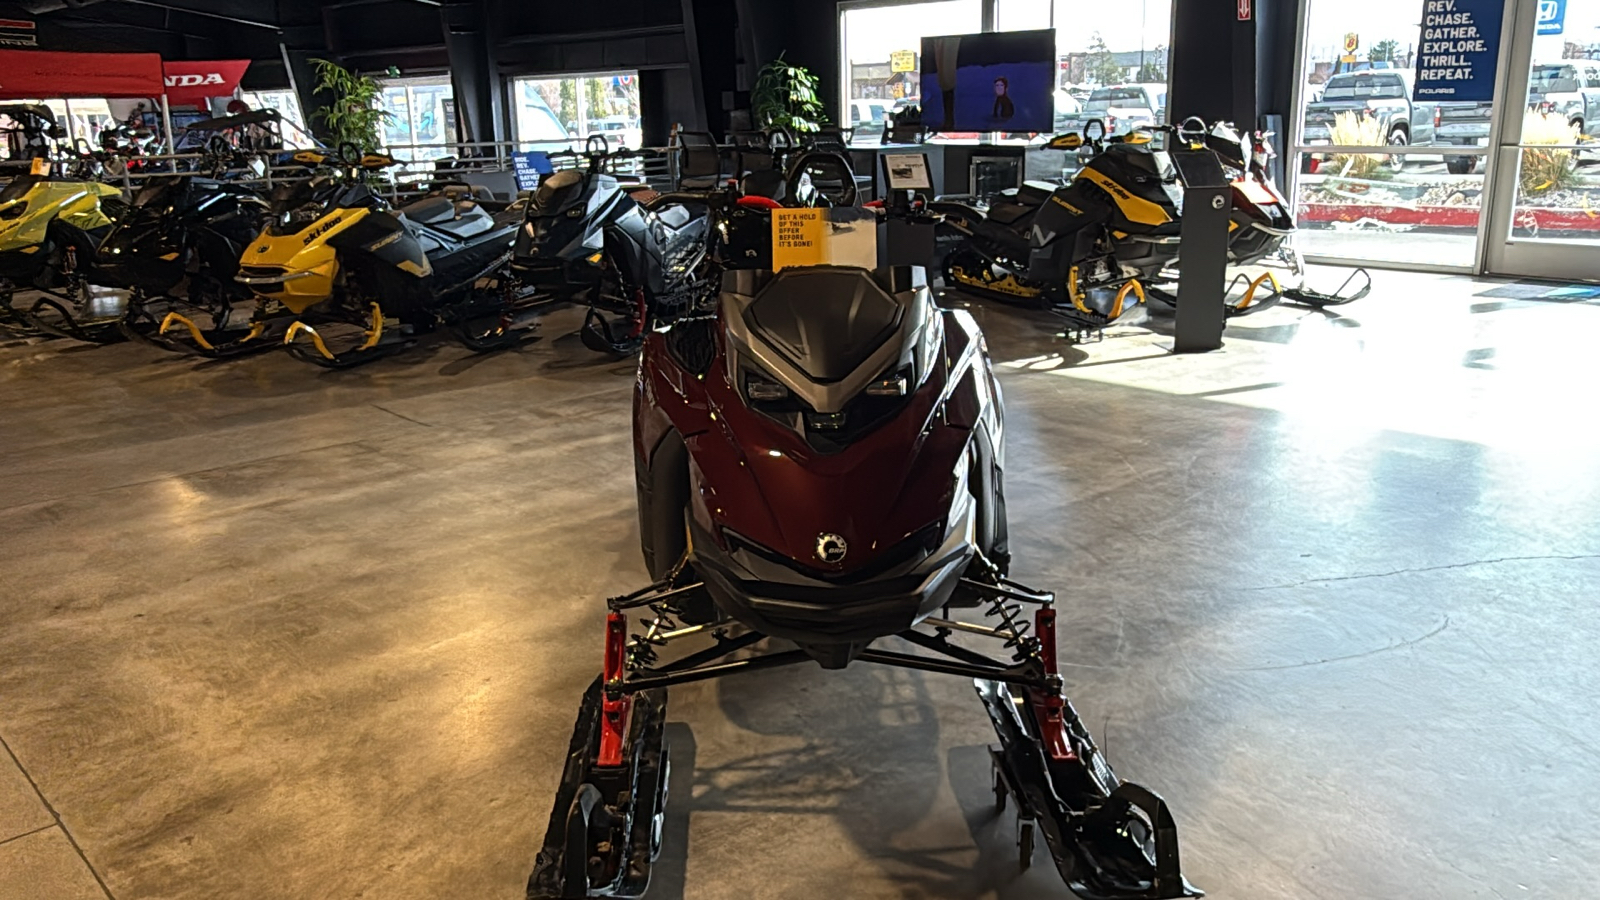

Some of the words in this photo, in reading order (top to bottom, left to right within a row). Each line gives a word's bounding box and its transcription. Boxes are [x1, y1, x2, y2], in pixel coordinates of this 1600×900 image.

[1428, 0, 1456, 12] REV.
[1426, 13, 1473, 26] CHASE.
[1425, 27, 1480, 39] GATHER.
[1423, 40, 1487, 53] EXPLORE.
[1422, 55, 1472, 67] THRILL.
[164, 73, 226, 87] NDA
[1420, 68, 1473, 80] REPEAT.
